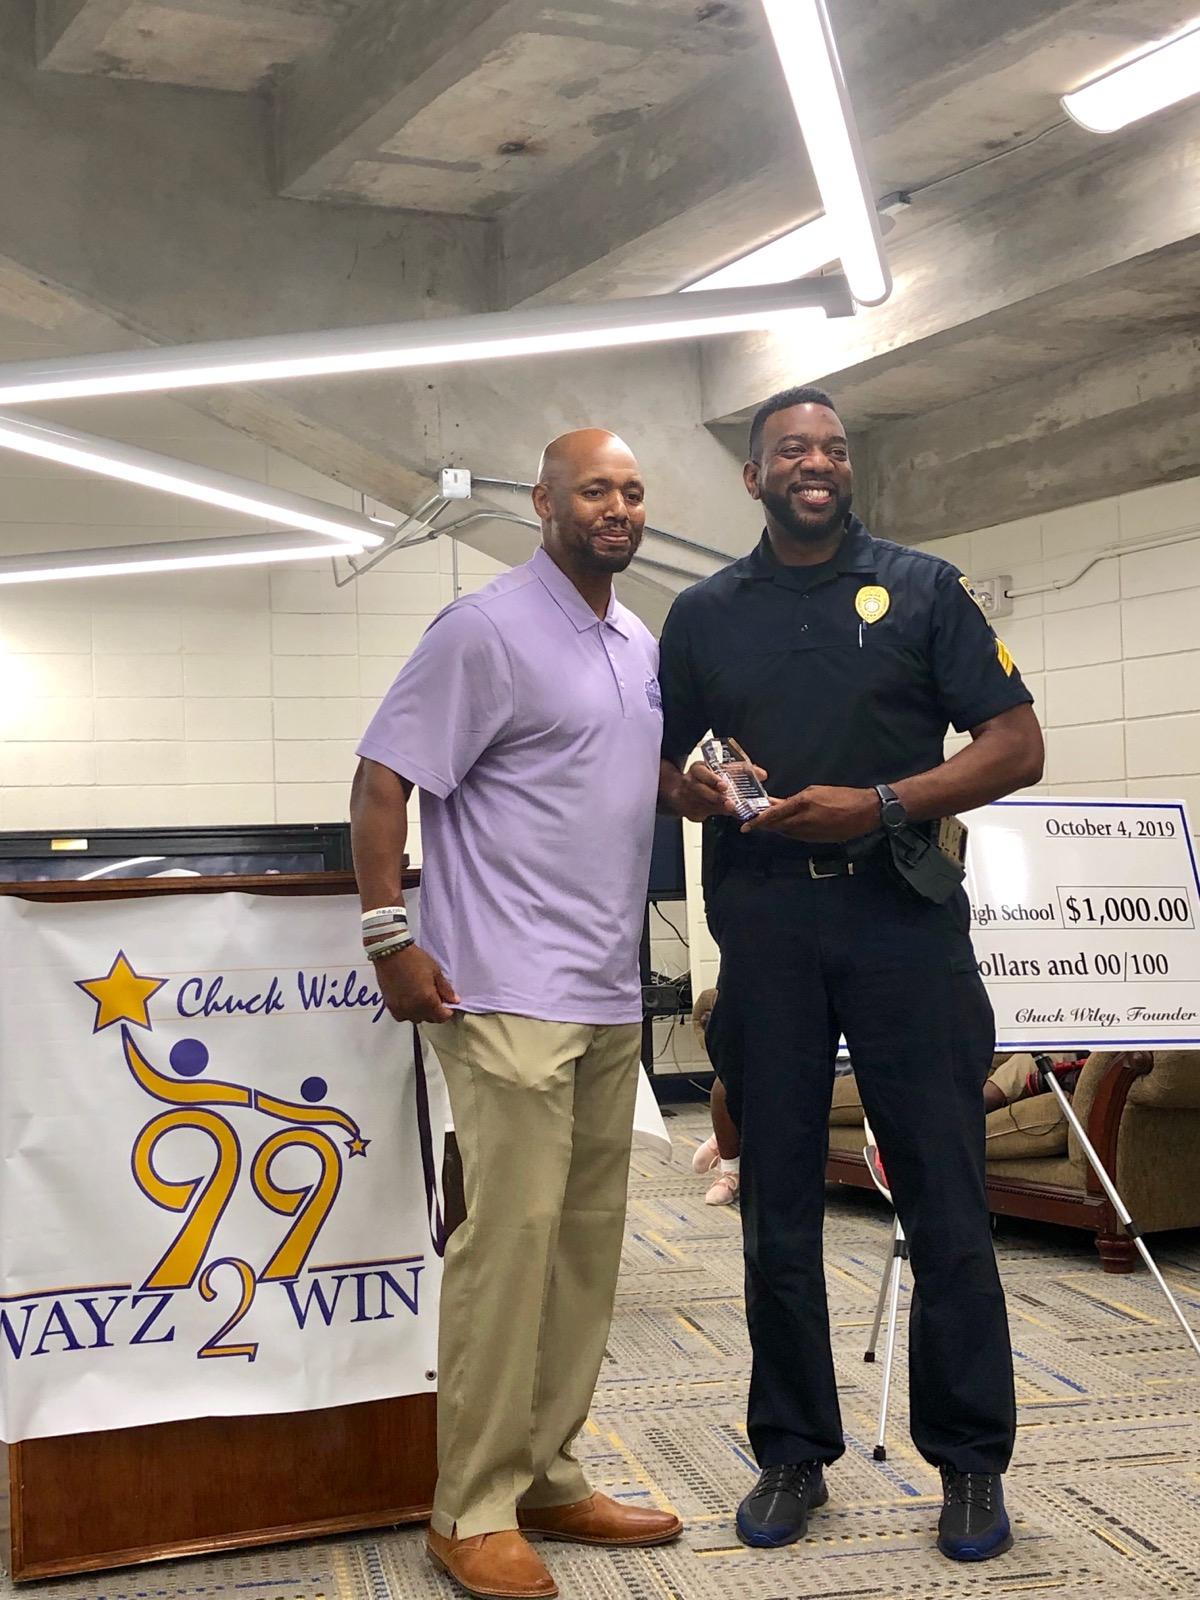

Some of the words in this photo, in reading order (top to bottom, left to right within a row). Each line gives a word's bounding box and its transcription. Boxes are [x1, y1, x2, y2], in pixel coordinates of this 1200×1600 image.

[1045, 818, 1112, 837] October
[1117, 820, 1133, 839] 4,
[1136, 820, 1176, 837] 2019
[970, 904, 998, 925] igh
[1001, 903, 1056, 921] School
[1066, 895, 1189, 926] $1,000.00
[979, 953, 1041, 977] ollars
[1047, 952, 1089, 976] and
[1094, 951, 1169, 982] 00/100
[176, 975, 285, 1018] Chuck
[297, 969, 386, 1024] Wiley
[1015, 1007, 1065, 1024] Chuck
[1070, 1007, 1121, 1028] Wiley,
[1126, 1006, 1198, 1022] Founder
[130, 1105, 344, 1291] 99
[196, 1256, 260, 1362] 2
[279, 1265, 426, 1330] WIN
